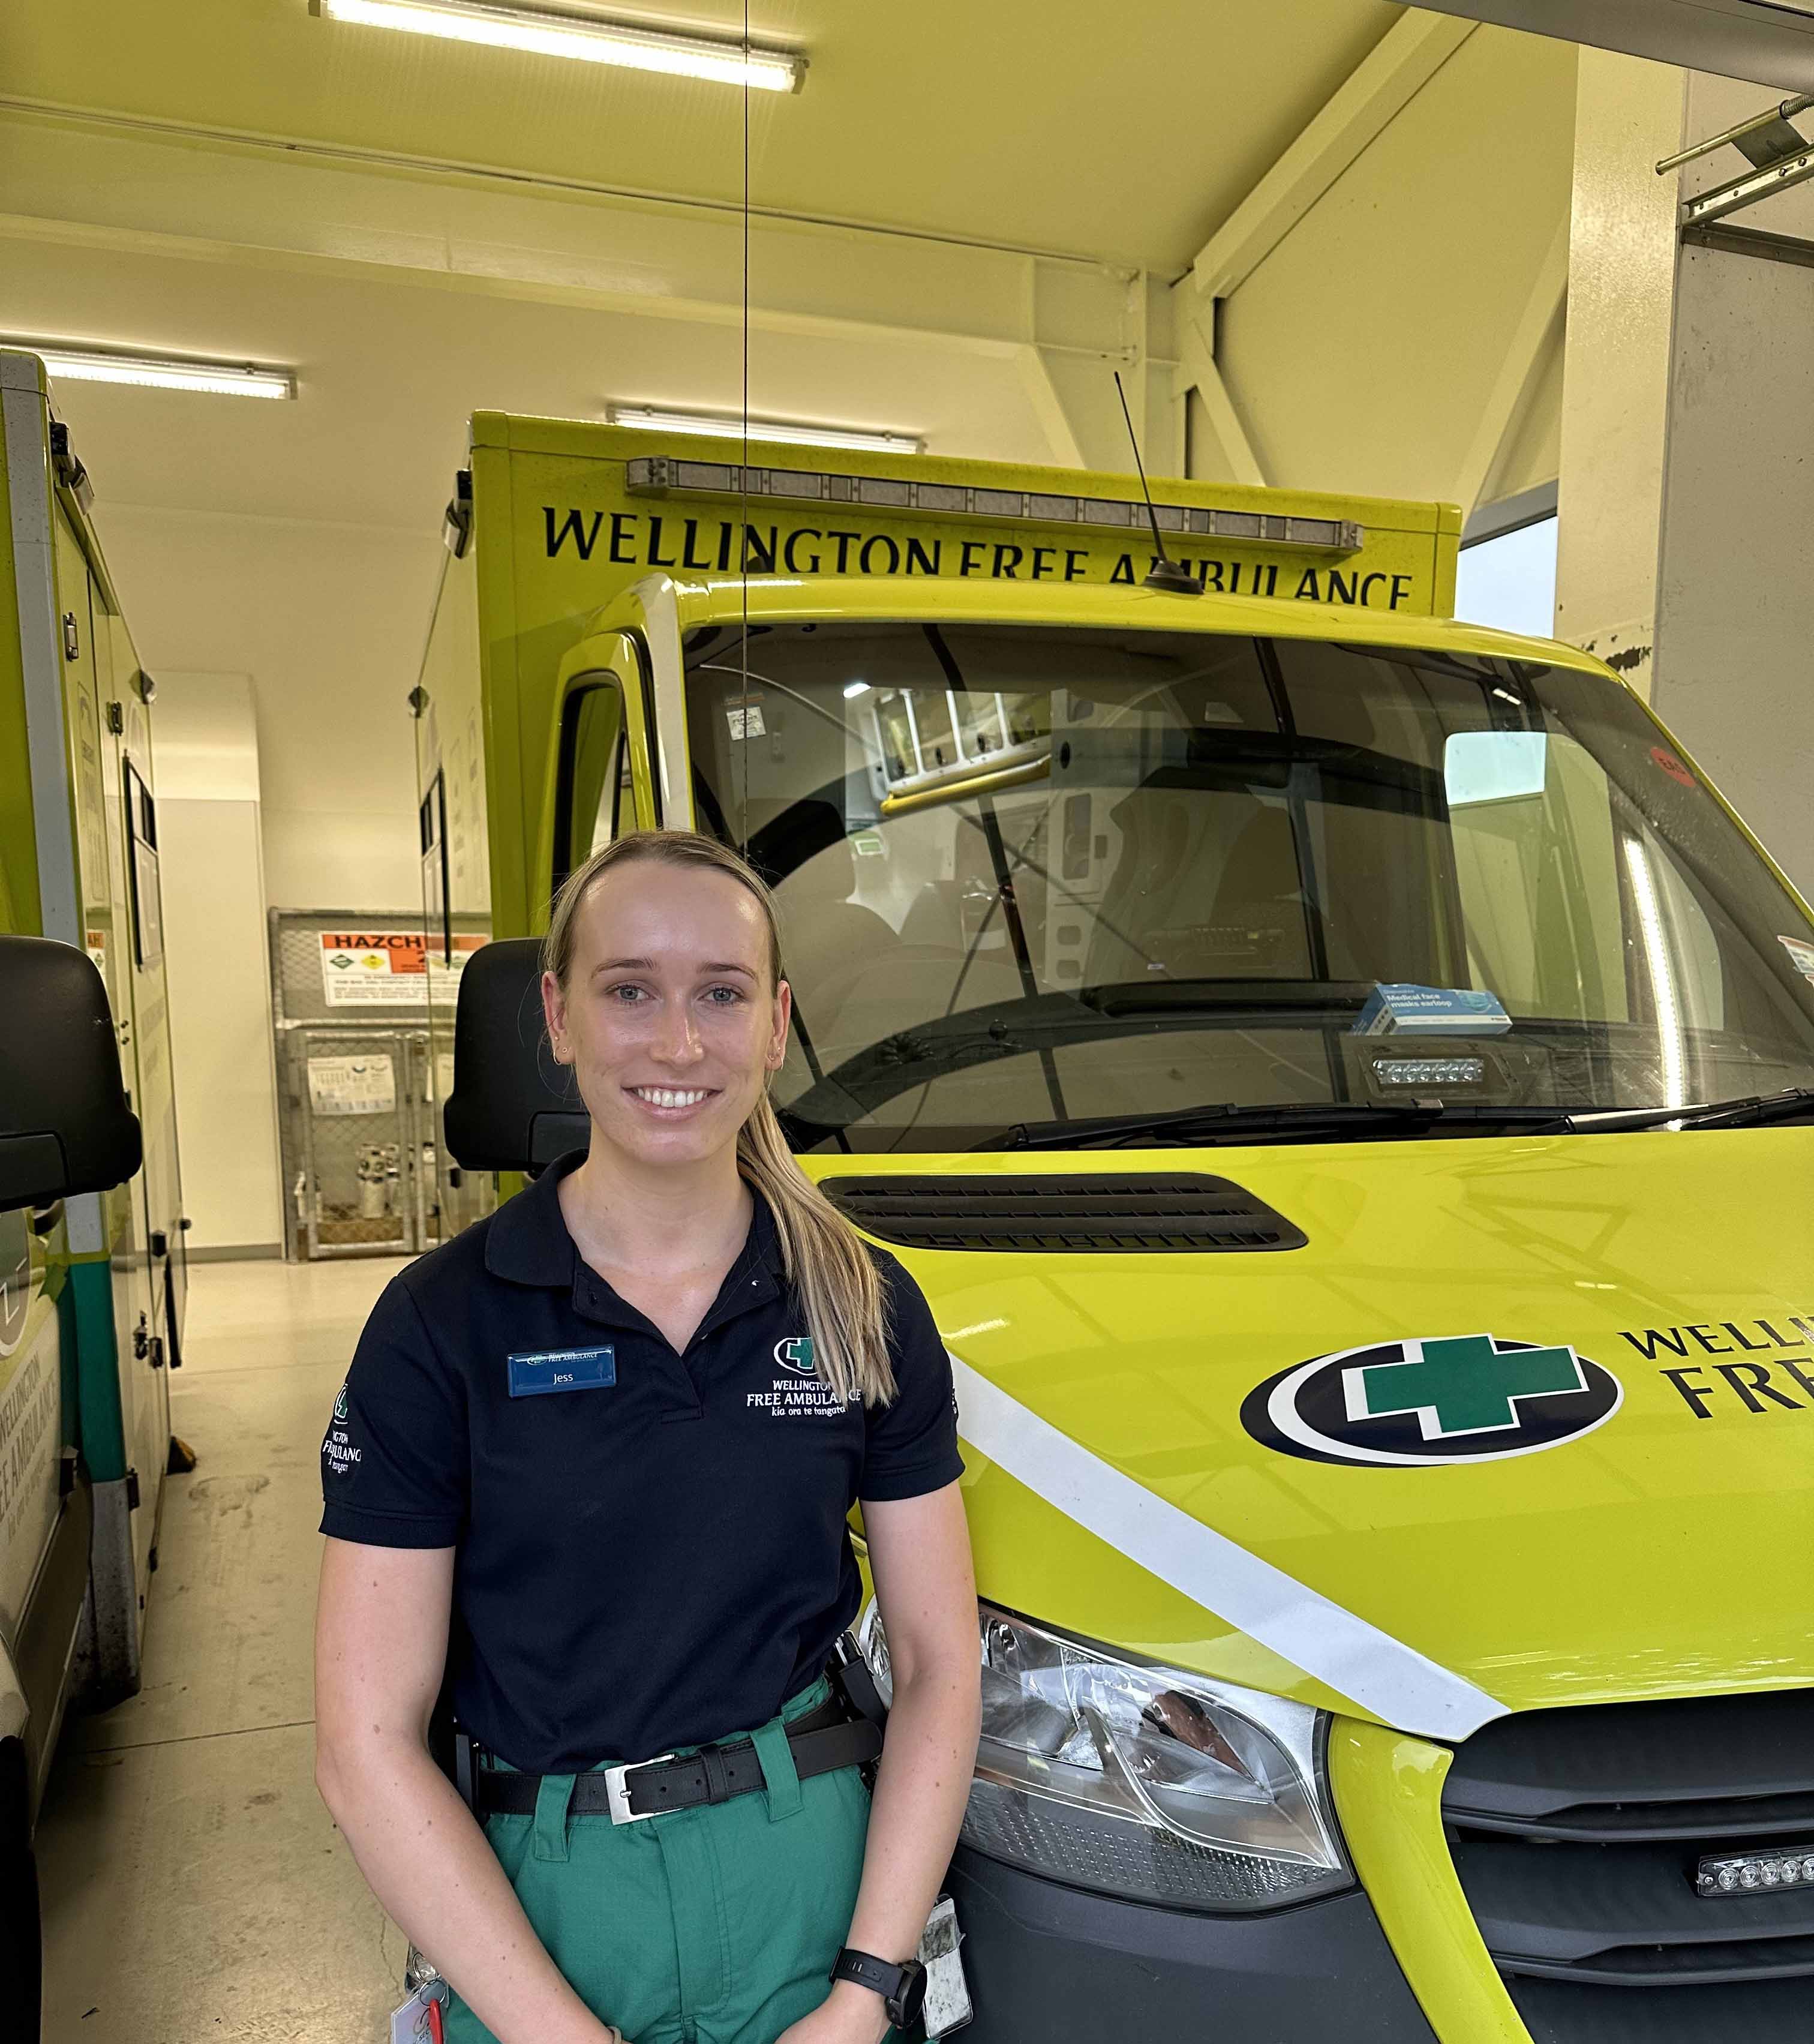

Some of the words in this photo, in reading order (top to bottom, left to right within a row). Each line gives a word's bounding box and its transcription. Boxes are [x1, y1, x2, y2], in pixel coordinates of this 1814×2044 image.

[542, 507, 941, 575] WELLINGTON
[960, 541, 1089, 581] FREE
[1616, 1317, 1814, 1360] WELLI
[553, 1373, 573, 1385] Jess
[747, 1393, 781, 1406] FREE
[784, 1389, 861, 1406] AMBULACE
[771, 1406, 786, 1416] kia
[804, 1407, 812, 1415] te
[814, 1406, 846, 1417] tangata
